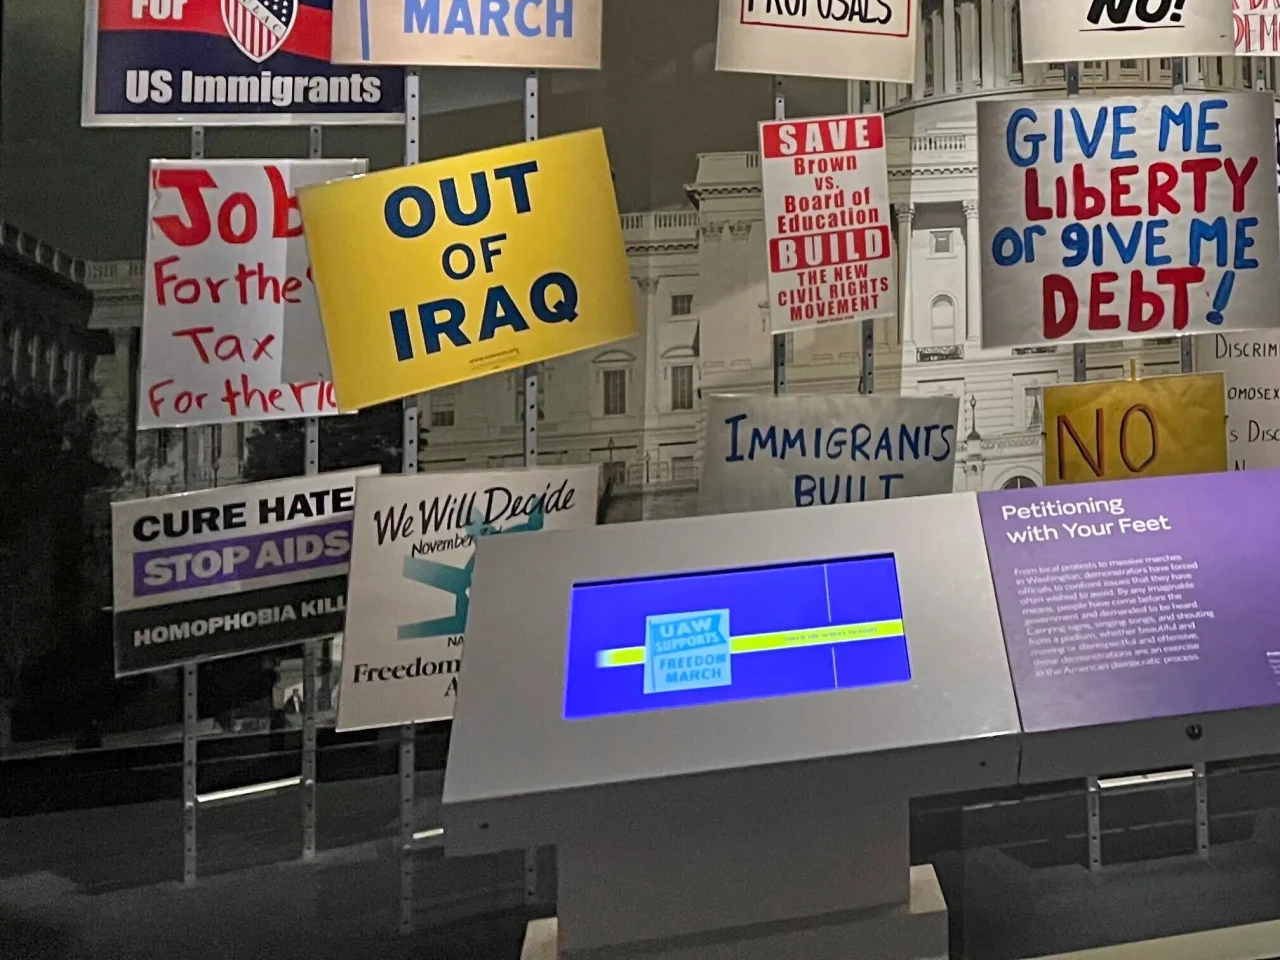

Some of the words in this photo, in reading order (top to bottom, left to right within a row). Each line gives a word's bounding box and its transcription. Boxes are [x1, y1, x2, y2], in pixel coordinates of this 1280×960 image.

[125, 69, 173, 103] US
[182, 71, 381, 106] Immigrants
[779, 118, 870, 156] SAVE
[1007, 105, 1137, 167] GIVE
[1159, 99, 1228, 153] ME
[794, 156, 857, 176] Brown
[815, 177, 839, 190] vs.
[384, 161, 539, 239] OUT
[785, 190, 844, 213] Board
[853, 187, 870, 205] of
[778, 208, 879, 234] Education
[441, 233, 507, 281] OF
[778, 228, 883, 270] BUILD
[992, 224, 1046, 267] or
[1189, 216, 1259, 269] ME
[778, 288, 822, 307] CIVIL
[830, 277, 889, 299] RIGHTS
[797, 270, 827, 287] THE
[834, 264, 868, 280] NEW
[389, 272, 579, 362] IRAQ
[790, 295, 879, 322] MOVEMENT
[172, 327, 275, 362] Tax
[148, 380, 209, 418] For
[724, 413, 955, 462] IMMIGRANTS
[1057, 403, 1158, 479] NO
[133, 503, 246, 541] CURE
[259, 487, 353, 524] HATE
[374, 511, 414, 545] We
[419, 493, 476, 537] Will
[483, 480, 574, 524] Decide
[1002, 497, 1125, 520] Petitioning
[412, 534, 476, 558] November
[1006, 526, 1058, 544] with
[1063, 522, 1114, 538] Your
[1118, 515, 1172, 534] Feet
[143, 551, 248, 587] STOP
[255, 529, 349, 569] AIDS
[134, 605, 295, 647] HOMOPHOBIA
[656, 632, 719, 653] SUPPORTS
[660, 617, 713, 638] UAW
[353, 662, 461, 683] Freedom
[659, 653, 726, 670] FREEDOM
[666, 668, 721, 684] MARCH
